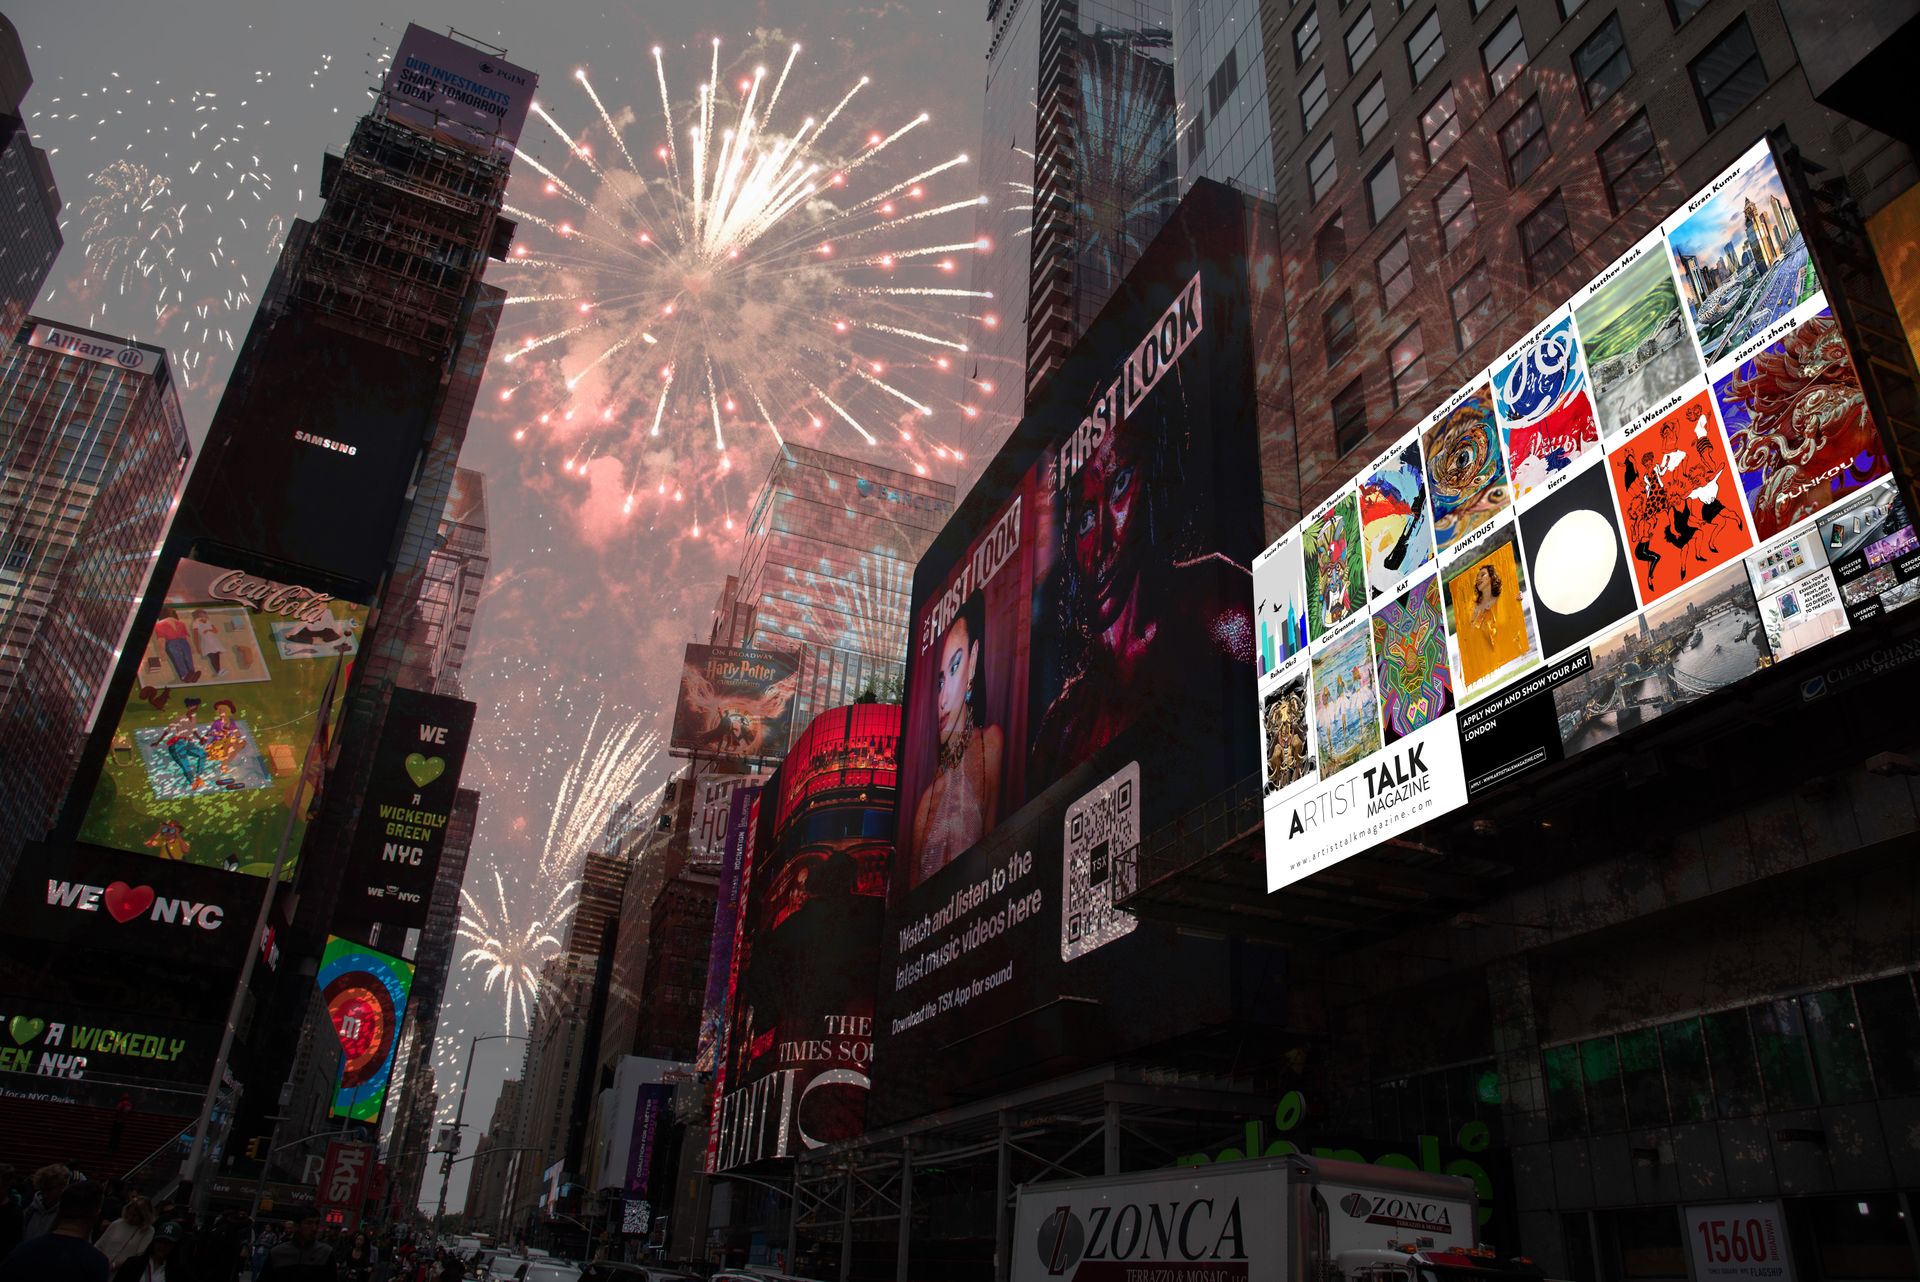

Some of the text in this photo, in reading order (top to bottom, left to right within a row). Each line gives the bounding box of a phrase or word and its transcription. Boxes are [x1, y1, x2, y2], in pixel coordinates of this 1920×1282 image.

[405, 57, 511, 106] OUR INVESTMENTS
[497, 69, 527, 86] PGIM
[396, 80, 435, 104] TODAY
[400, 68, 508, 118] SHAPE TOMORROW
[1688, 166, 1741, 213] Kiran Kumar
[1589, 248, 1642, 294] Matthew Mark
[46, 331, 115, 360] Allianz
[1506, 351, 1518, 361] Lee
[1519, 337, 1535, 354] sung
[1734, 316, 1797, 364] xiaorui zhong
[1060, 376, 1121, 490] FIRST
[1126, 278, 1201, 410] LOOK
[1624, 394, 1682, 438] Saki Watanabe
[294, 430, 358, 456] SAMSUNG
[1372, 455, 1389, 471] Davide
[1454, 520, 1495, 554] JUNKYDUST
[1774, 525, 1816, 551] PHYSICAL EXHIBITION
[930, 563, 971, 647] FIRST
[974, 500, 1020, 587] LOOK
[1839, 558, 1862, 573] LEICESTER
[1843, 564, 1862, 577] SQUARE
[1396, 580, 1409, 594] KAT
[1799, 576, 1830, 595] EXHIBITED ART
[1801, 573, 1824, 588] SELL YOUR
[1818, 583, 1829, 591] AND
[208, 569, 336, 624] Coca-Cola
[1804, 588, 1831, 603] ALL PROFITS
[1811, 603, 1821, 611] THE
[1820, 596, 1836, 608] ARTIST
[1812, 592, 1833, 606] DIRECTLY
[1853, 603, 1879, 618] LIVERPOOL
[1860, 610, 1877, 621] STREET
[706, 660, 776, 681] Harry Potter
[1463, 655, 1588, 728] APPLY NOW AND SHOW YOUR ART
[418, 724, 449, 745] WE
[1464, 719, 1497, 742] LONDON
[411, 793, 422, 807] A
[1288, 741, 1428, 840] ARTIST TALK
[1366, 774, 1431, 818] MAGAZINE
[378, 804, 447, 829] WICKEDLY
[385, 821, 432, 842] GREEN
[1289, 798, 1433, 871] www.artisttalkmagazine.com
[381, 842, 424, 867] NYC
[1092, 853, 1107, 873] TSX
[46, 879, 225, 931] WE NYC
[367, 886, 421, 904] WE NYC
[899, 850, 1033, 954] Watch and listen to the
[895, 888, 1042, 992] latest music videos here
[891, 960, 1013, 1036] Download the TSX App for sound
[824, 1014, 872, 1037] THE
[43, 1022, 186, 1062] A WICKEDLY
[778, 1040, 832, 1063] TIMES
[36, 1052, 88, 1082] NYC
[329, 1149, 365, 1202] tkts
[1372, 1197, 1450, 1225] ZONCA
[1083, 1196, 1249, 1260] ZONCA
[1698, 1218, 1767, 1263] 1560
[1750, 1266, 1783, 1277] FLAGSHIP
